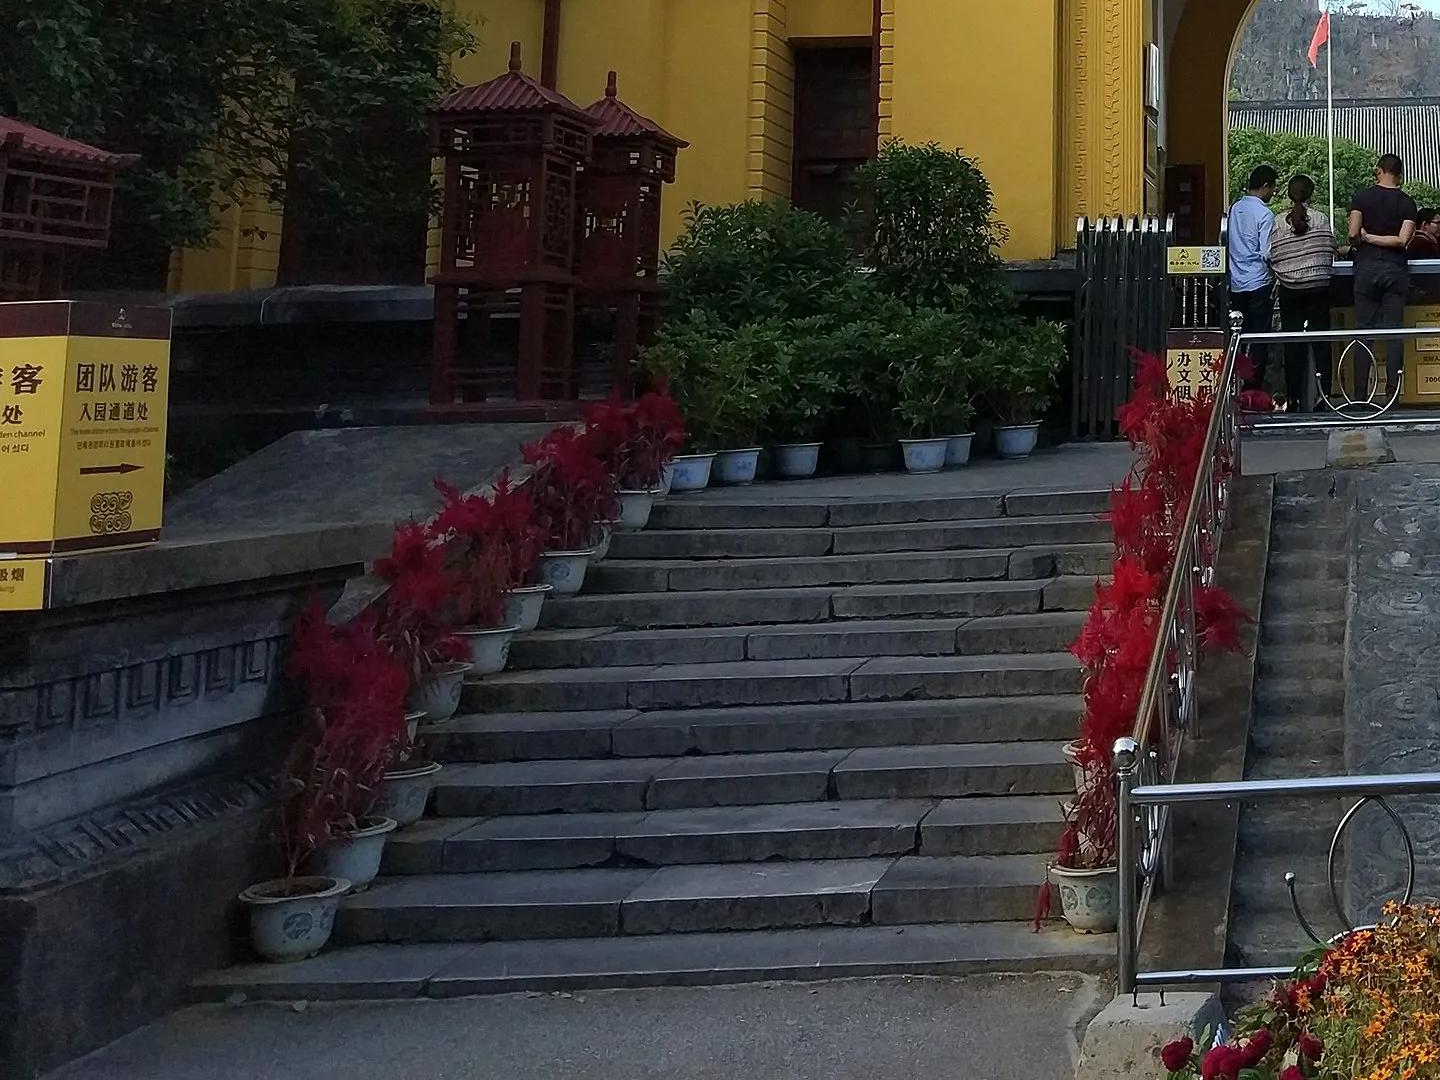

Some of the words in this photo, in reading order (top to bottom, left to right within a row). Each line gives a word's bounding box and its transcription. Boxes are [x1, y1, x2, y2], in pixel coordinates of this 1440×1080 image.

[0, 363, 44, 395] 客
[75, 362, 159, 393] 团队游客
[1, 404, 23, 425] 处
[79, 401, 149, 422] 入园通道处
[14, 429, 46, 438] channel
